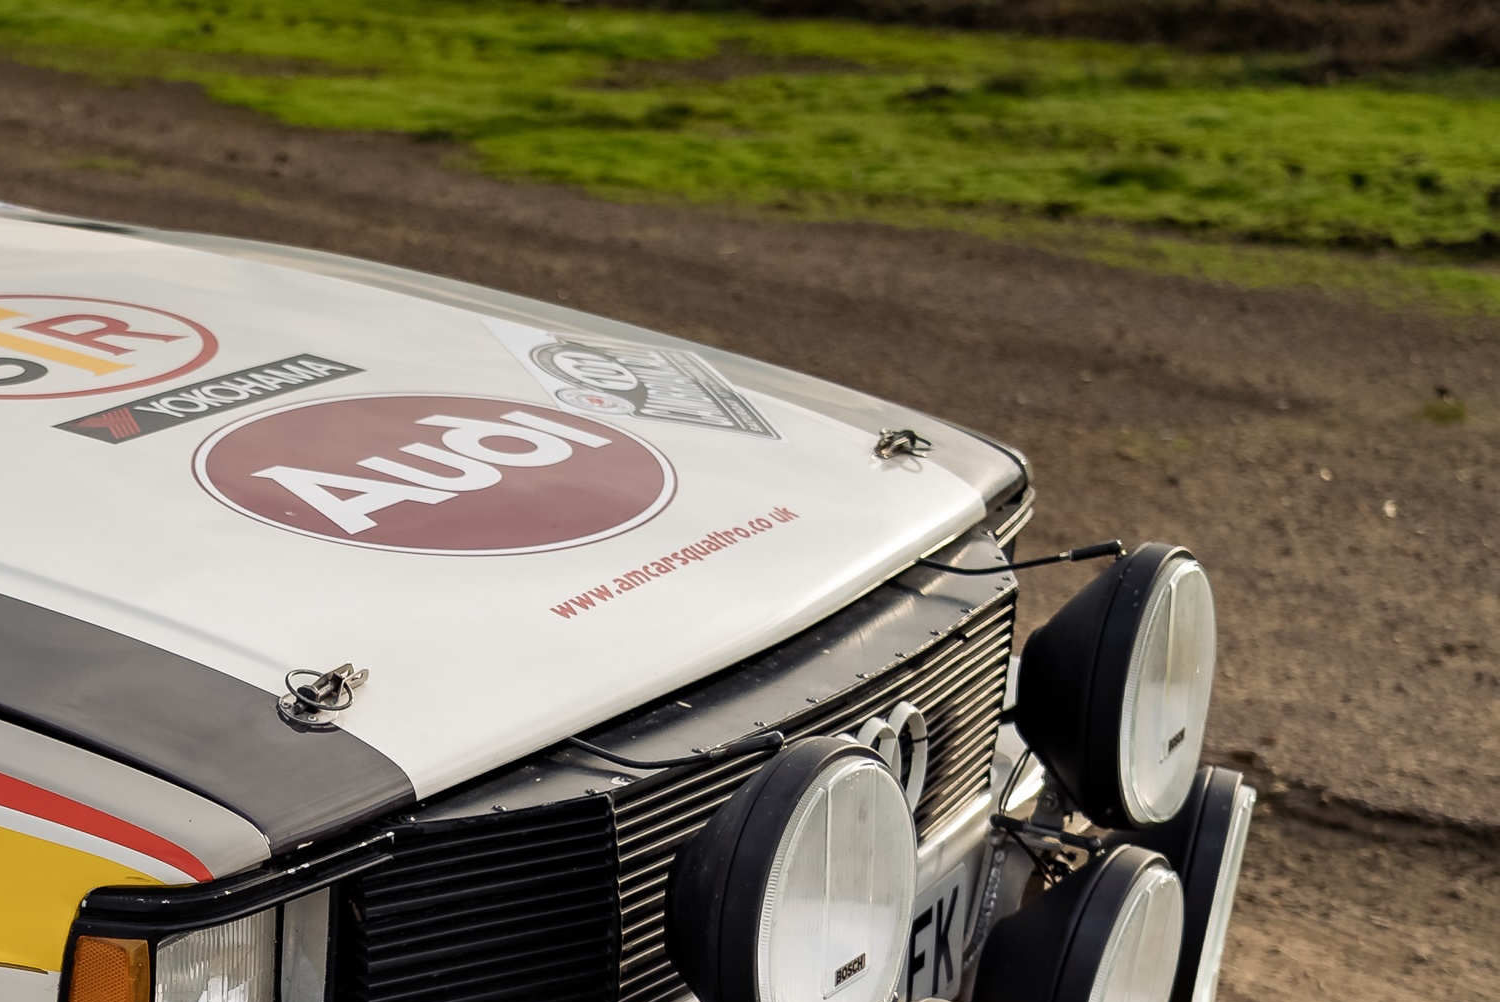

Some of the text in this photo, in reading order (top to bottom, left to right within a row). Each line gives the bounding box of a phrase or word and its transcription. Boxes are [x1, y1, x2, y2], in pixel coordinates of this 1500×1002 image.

[134, 357, 348, 418] YOKOHAMA
[250, 410, 614, 536] Audi
[835, 953, 866, 986] BOSCH
